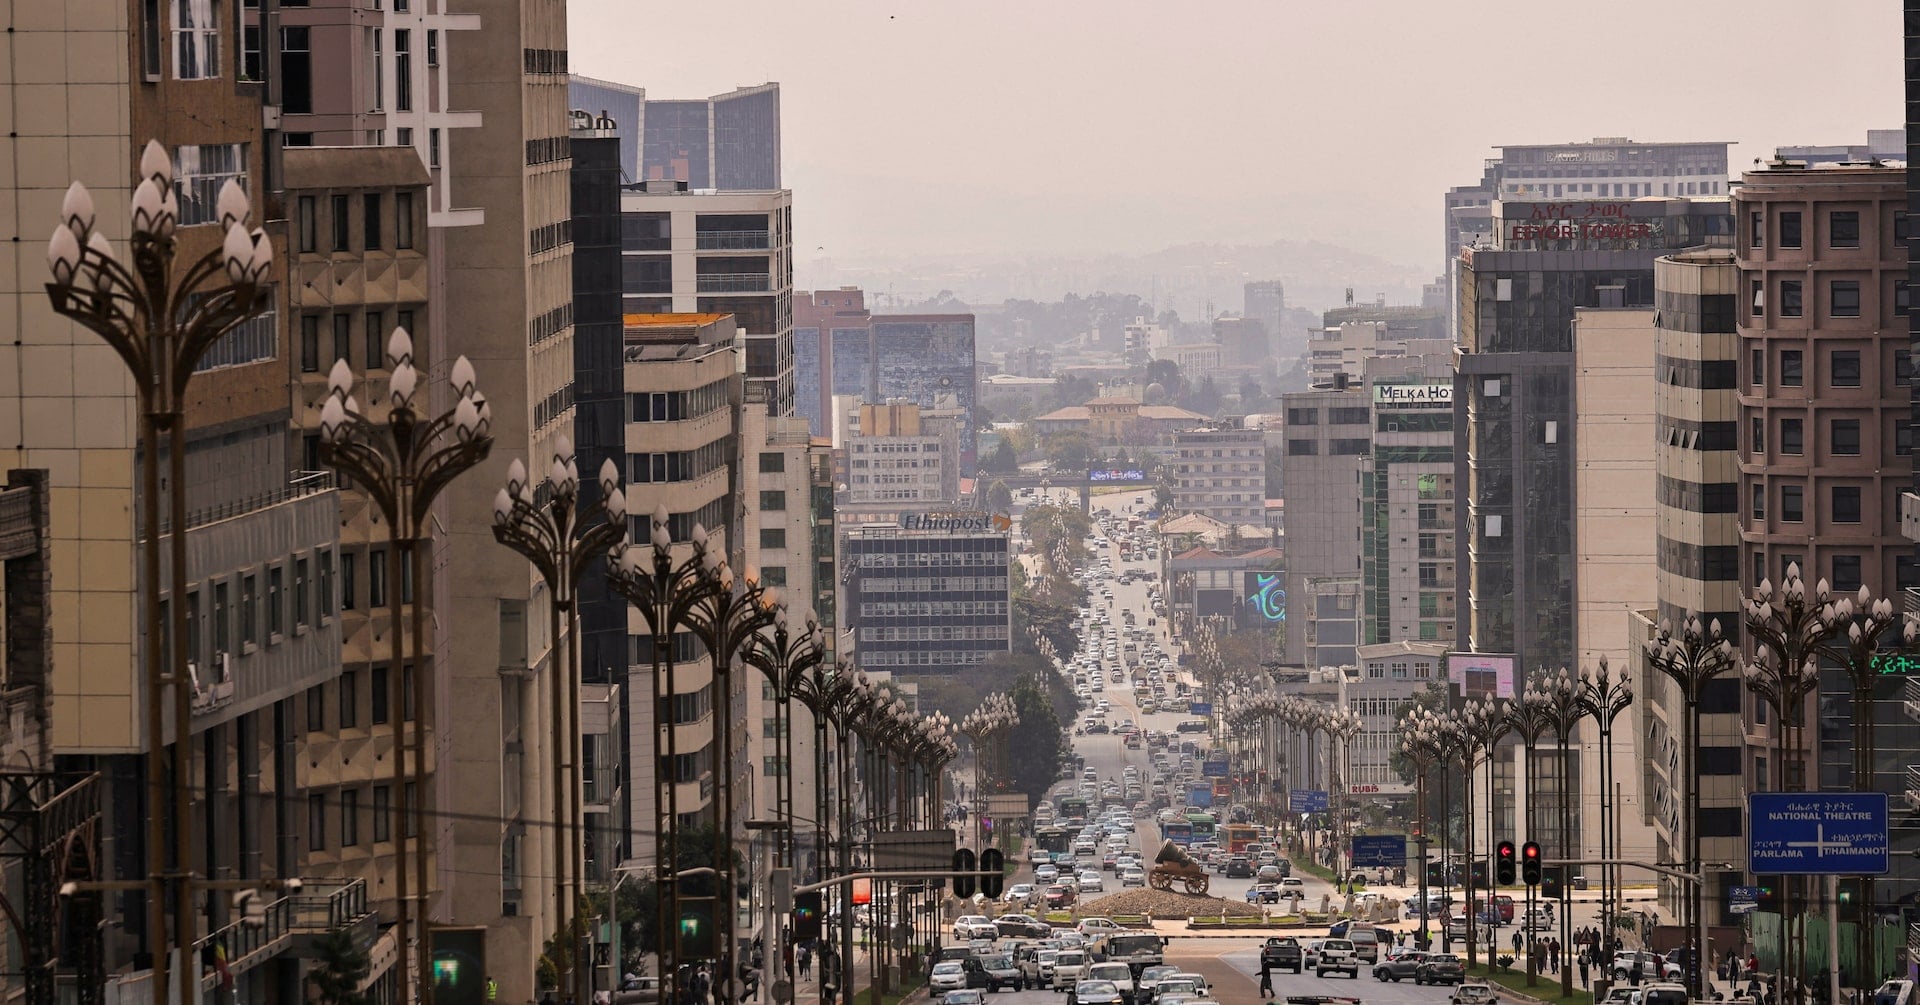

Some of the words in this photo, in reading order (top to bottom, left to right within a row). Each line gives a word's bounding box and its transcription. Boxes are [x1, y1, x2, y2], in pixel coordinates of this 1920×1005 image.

[1580, 224, 1650, 240] TOWER
[904, 514, 991, 534] Ethiopost
[1769, 812, 1821, 820] NATIONAL
[1824, 812, 1872, 820] THEATRE
[1753, 849, 1804, 858] PARLAMA
